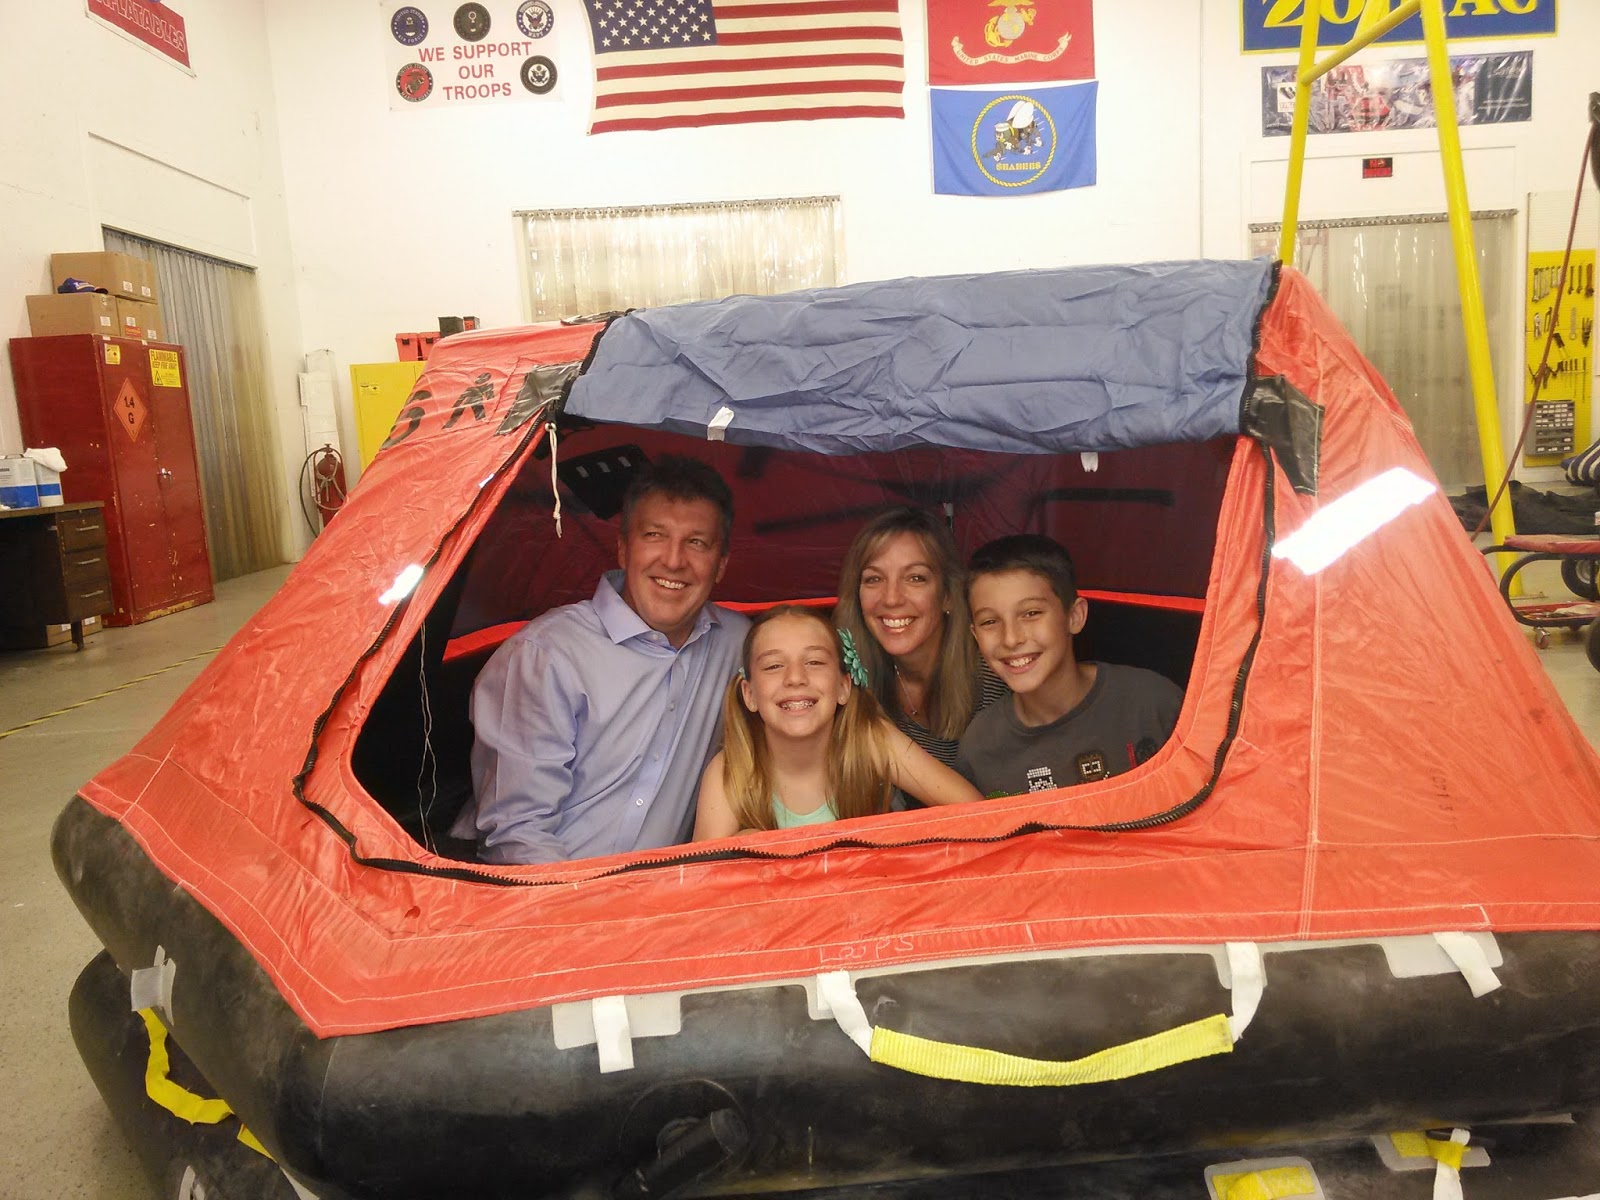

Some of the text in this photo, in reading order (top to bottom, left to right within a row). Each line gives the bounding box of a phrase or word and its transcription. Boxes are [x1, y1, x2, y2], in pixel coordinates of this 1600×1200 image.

[1263, 0, 1538, 28] ZOA
[96, 0, 186, 52] LATABLES
[418, 42, 532, 62] WE SUPPORT
[956, 47, 1064, 65] UNITED STATES MARINE CORPS
[458, 64, 494, 79] OUR
[443, 82, 512, 100] TROOPS
[995, 161, 1041, 171] SEABEES
[128, 412, 135, 424] G
